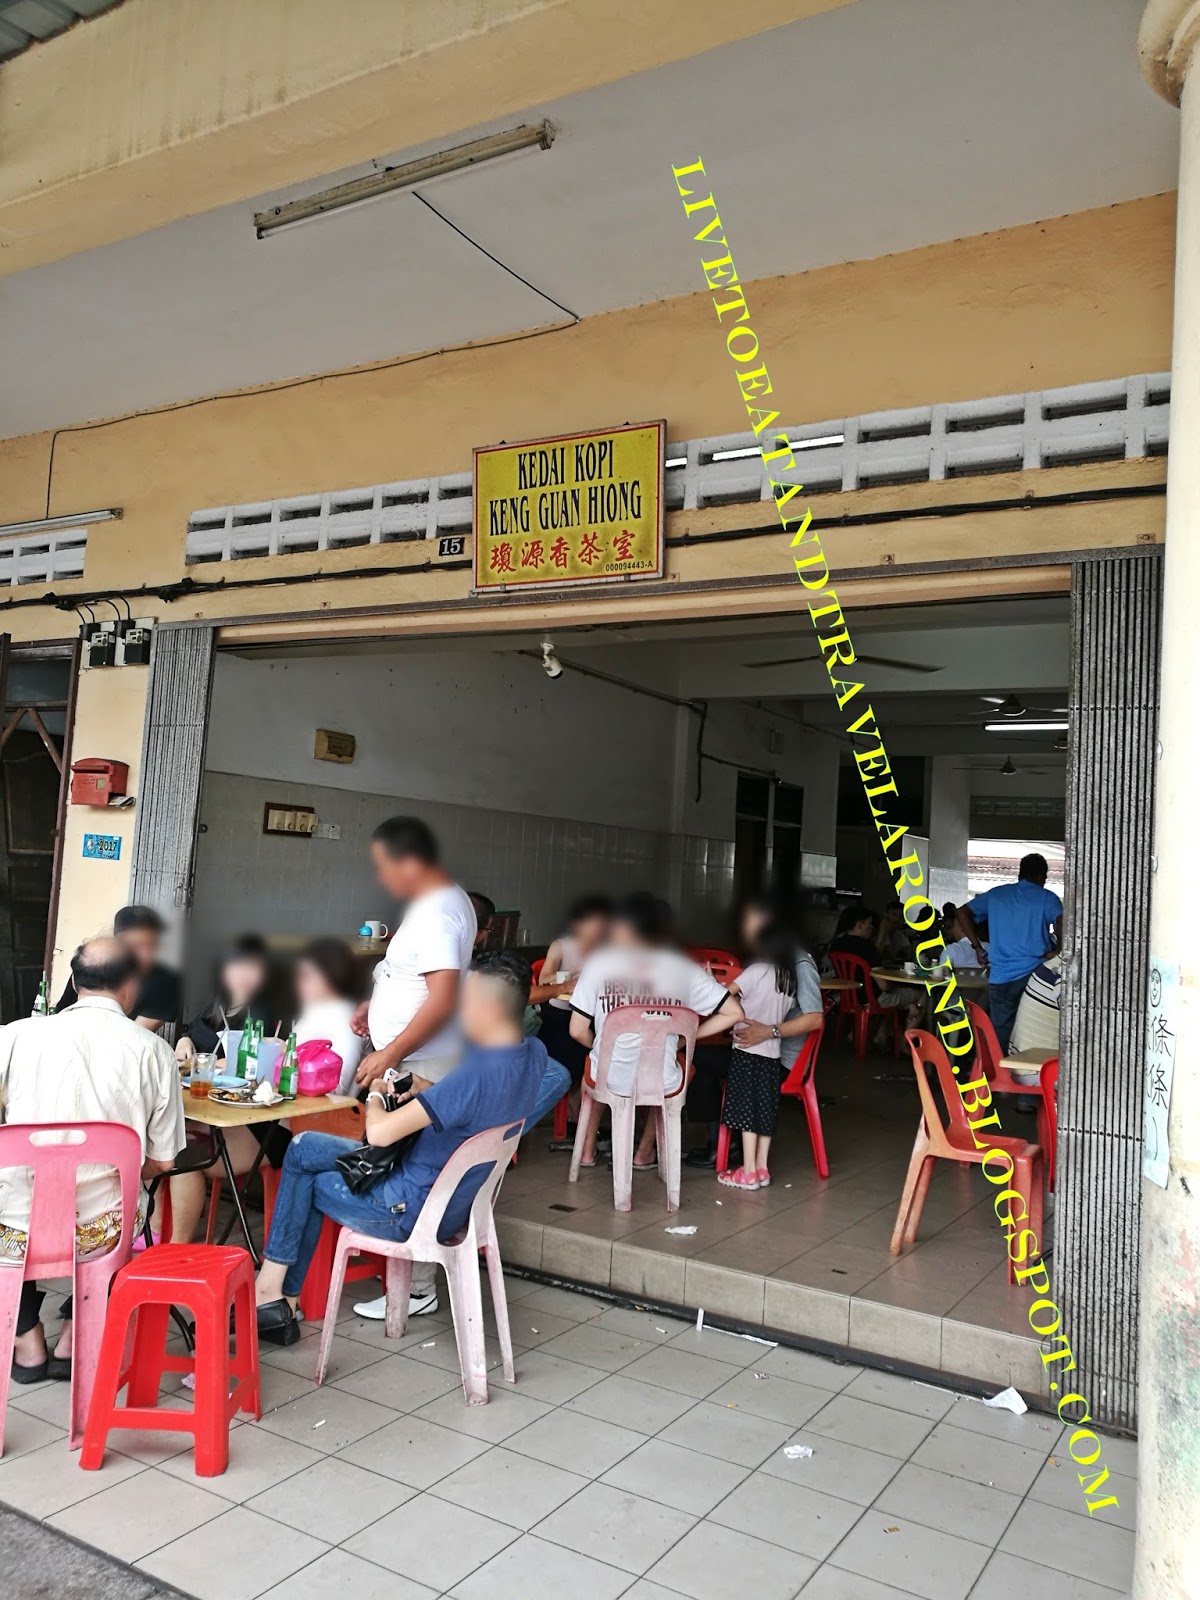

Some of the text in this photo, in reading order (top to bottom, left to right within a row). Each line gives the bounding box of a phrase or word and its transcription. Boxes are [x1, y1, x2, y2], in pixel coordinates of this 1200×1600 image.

[517, 440, 614, 490] KEDAI KOPI
[489, 480, 642, 536] KENG GUAN HIONG
[441, 538, 462, 556] 15
[489, 529, 636, 574] 瓊源香茶室
[605, 560, 654, 572] 000094443-A
[99, 840, 117, 851] 2017
[599, 995, 626, 1013] THE
